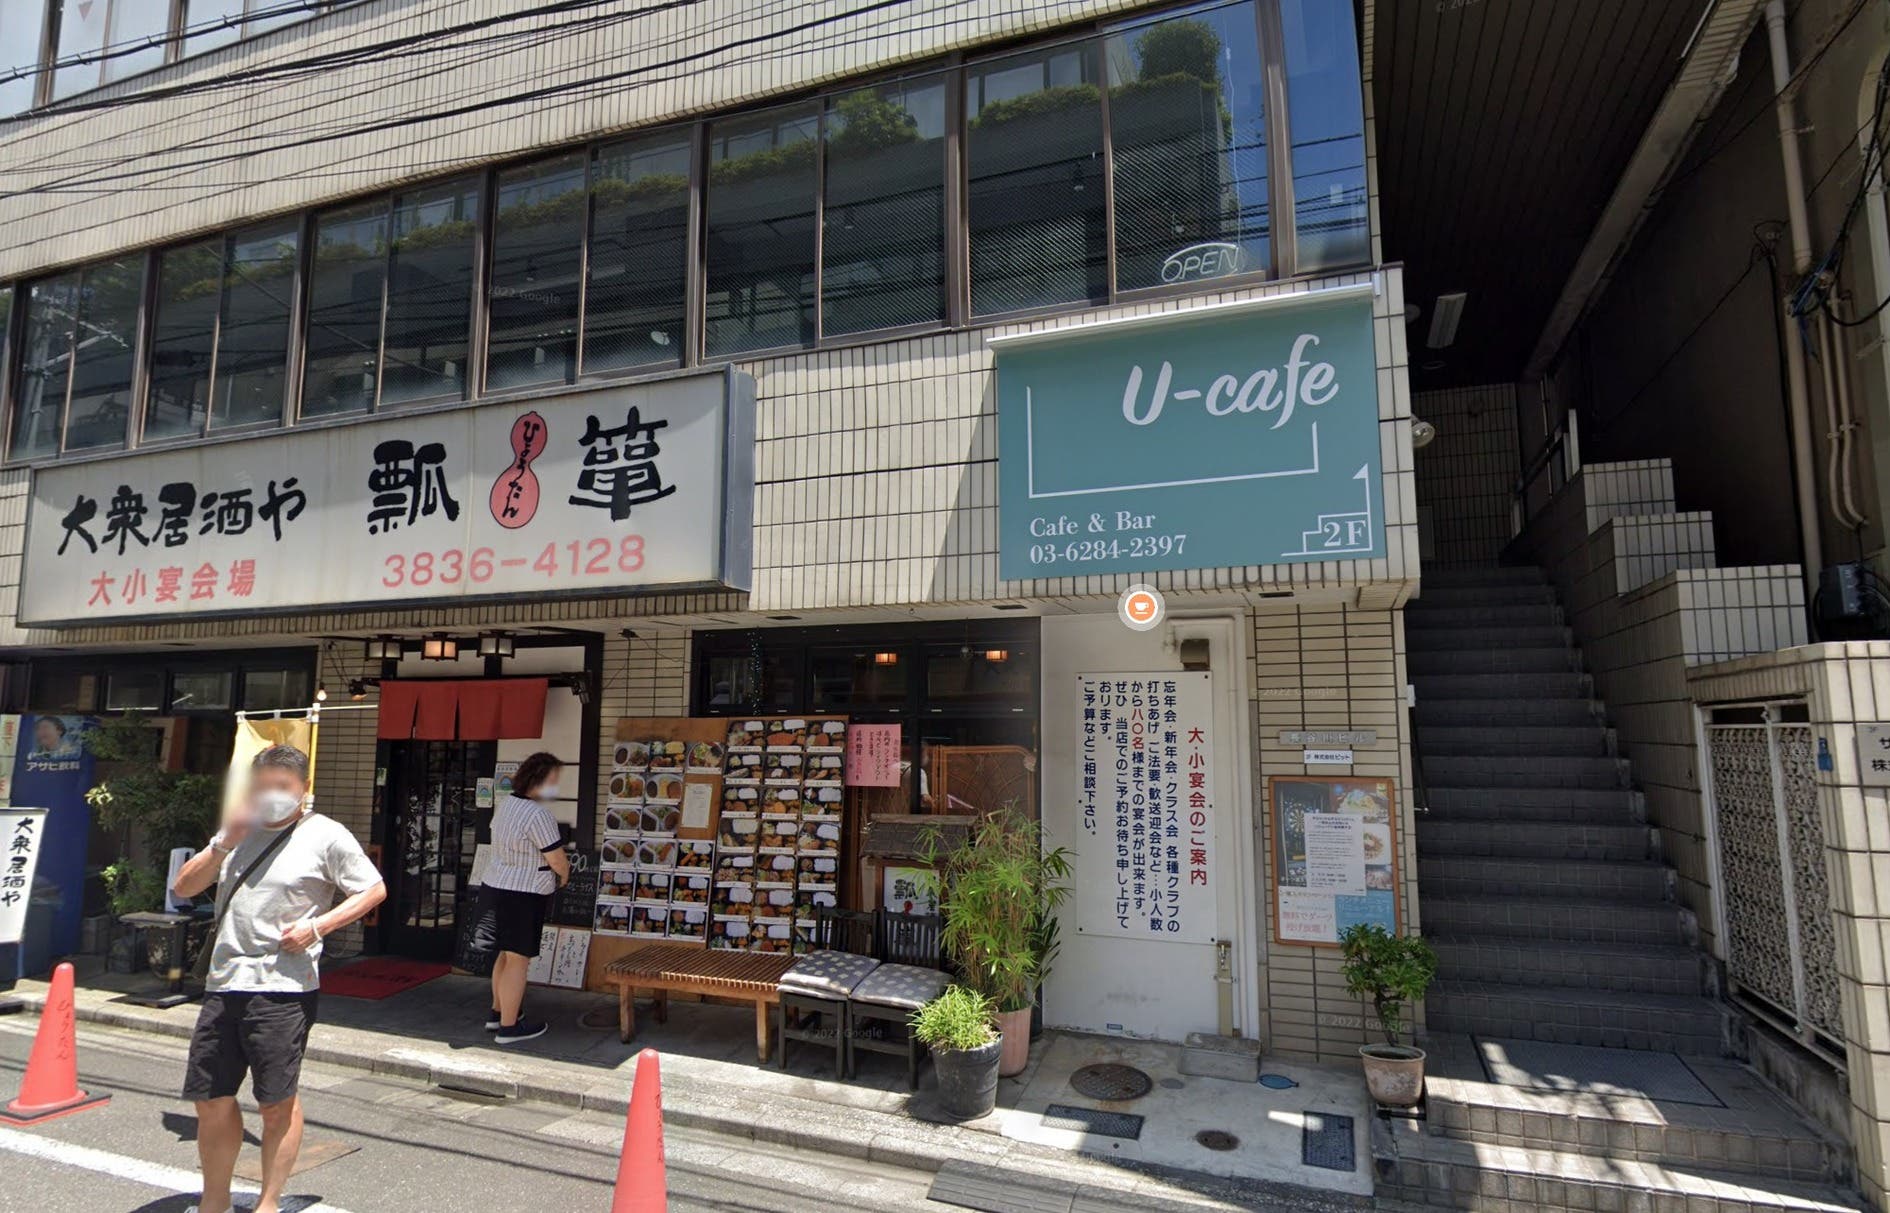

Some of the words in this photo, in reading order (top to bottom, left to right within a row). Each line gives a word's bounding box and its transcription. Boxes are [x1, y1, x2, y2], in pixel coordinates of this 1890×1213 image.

[1161, 248, 1239, 282] OPEN
[1121, 333, 1340, 430] U-cafe
[502, 420, 540, 518] ひょうたん
[57, 477, 306, 556] 大衆居酒や
[1029, 515, 1079, 538] Cafe
[1087, 512, 1106, 533] &
[1115, 510, 1156, 531] Bar
[1323, 520, 1366, 548] 2F
[382, 534, 646, 588] 3836-4128
[1029, 534, 1187, 564] 03-6284-2397
[88, 560, 256, 606] 大小宴会場
[1099, 680, 1112, 741] おります。
[1115, 680, 1128, 707] ぜひ
[26, 761, 81, 772] アサヒ飲料
[1083, 680, 1097, 836] ご予算などご相談下さい。
[1871, 758, 1890, 772] 株
[1115, 717, 1130, 930] 当店でのご予約お待ち申し上げて
[1187, 727, 1208, 886] 大・小宴会のご案内
[2, 816, 34, 907] 大衆居酒や
